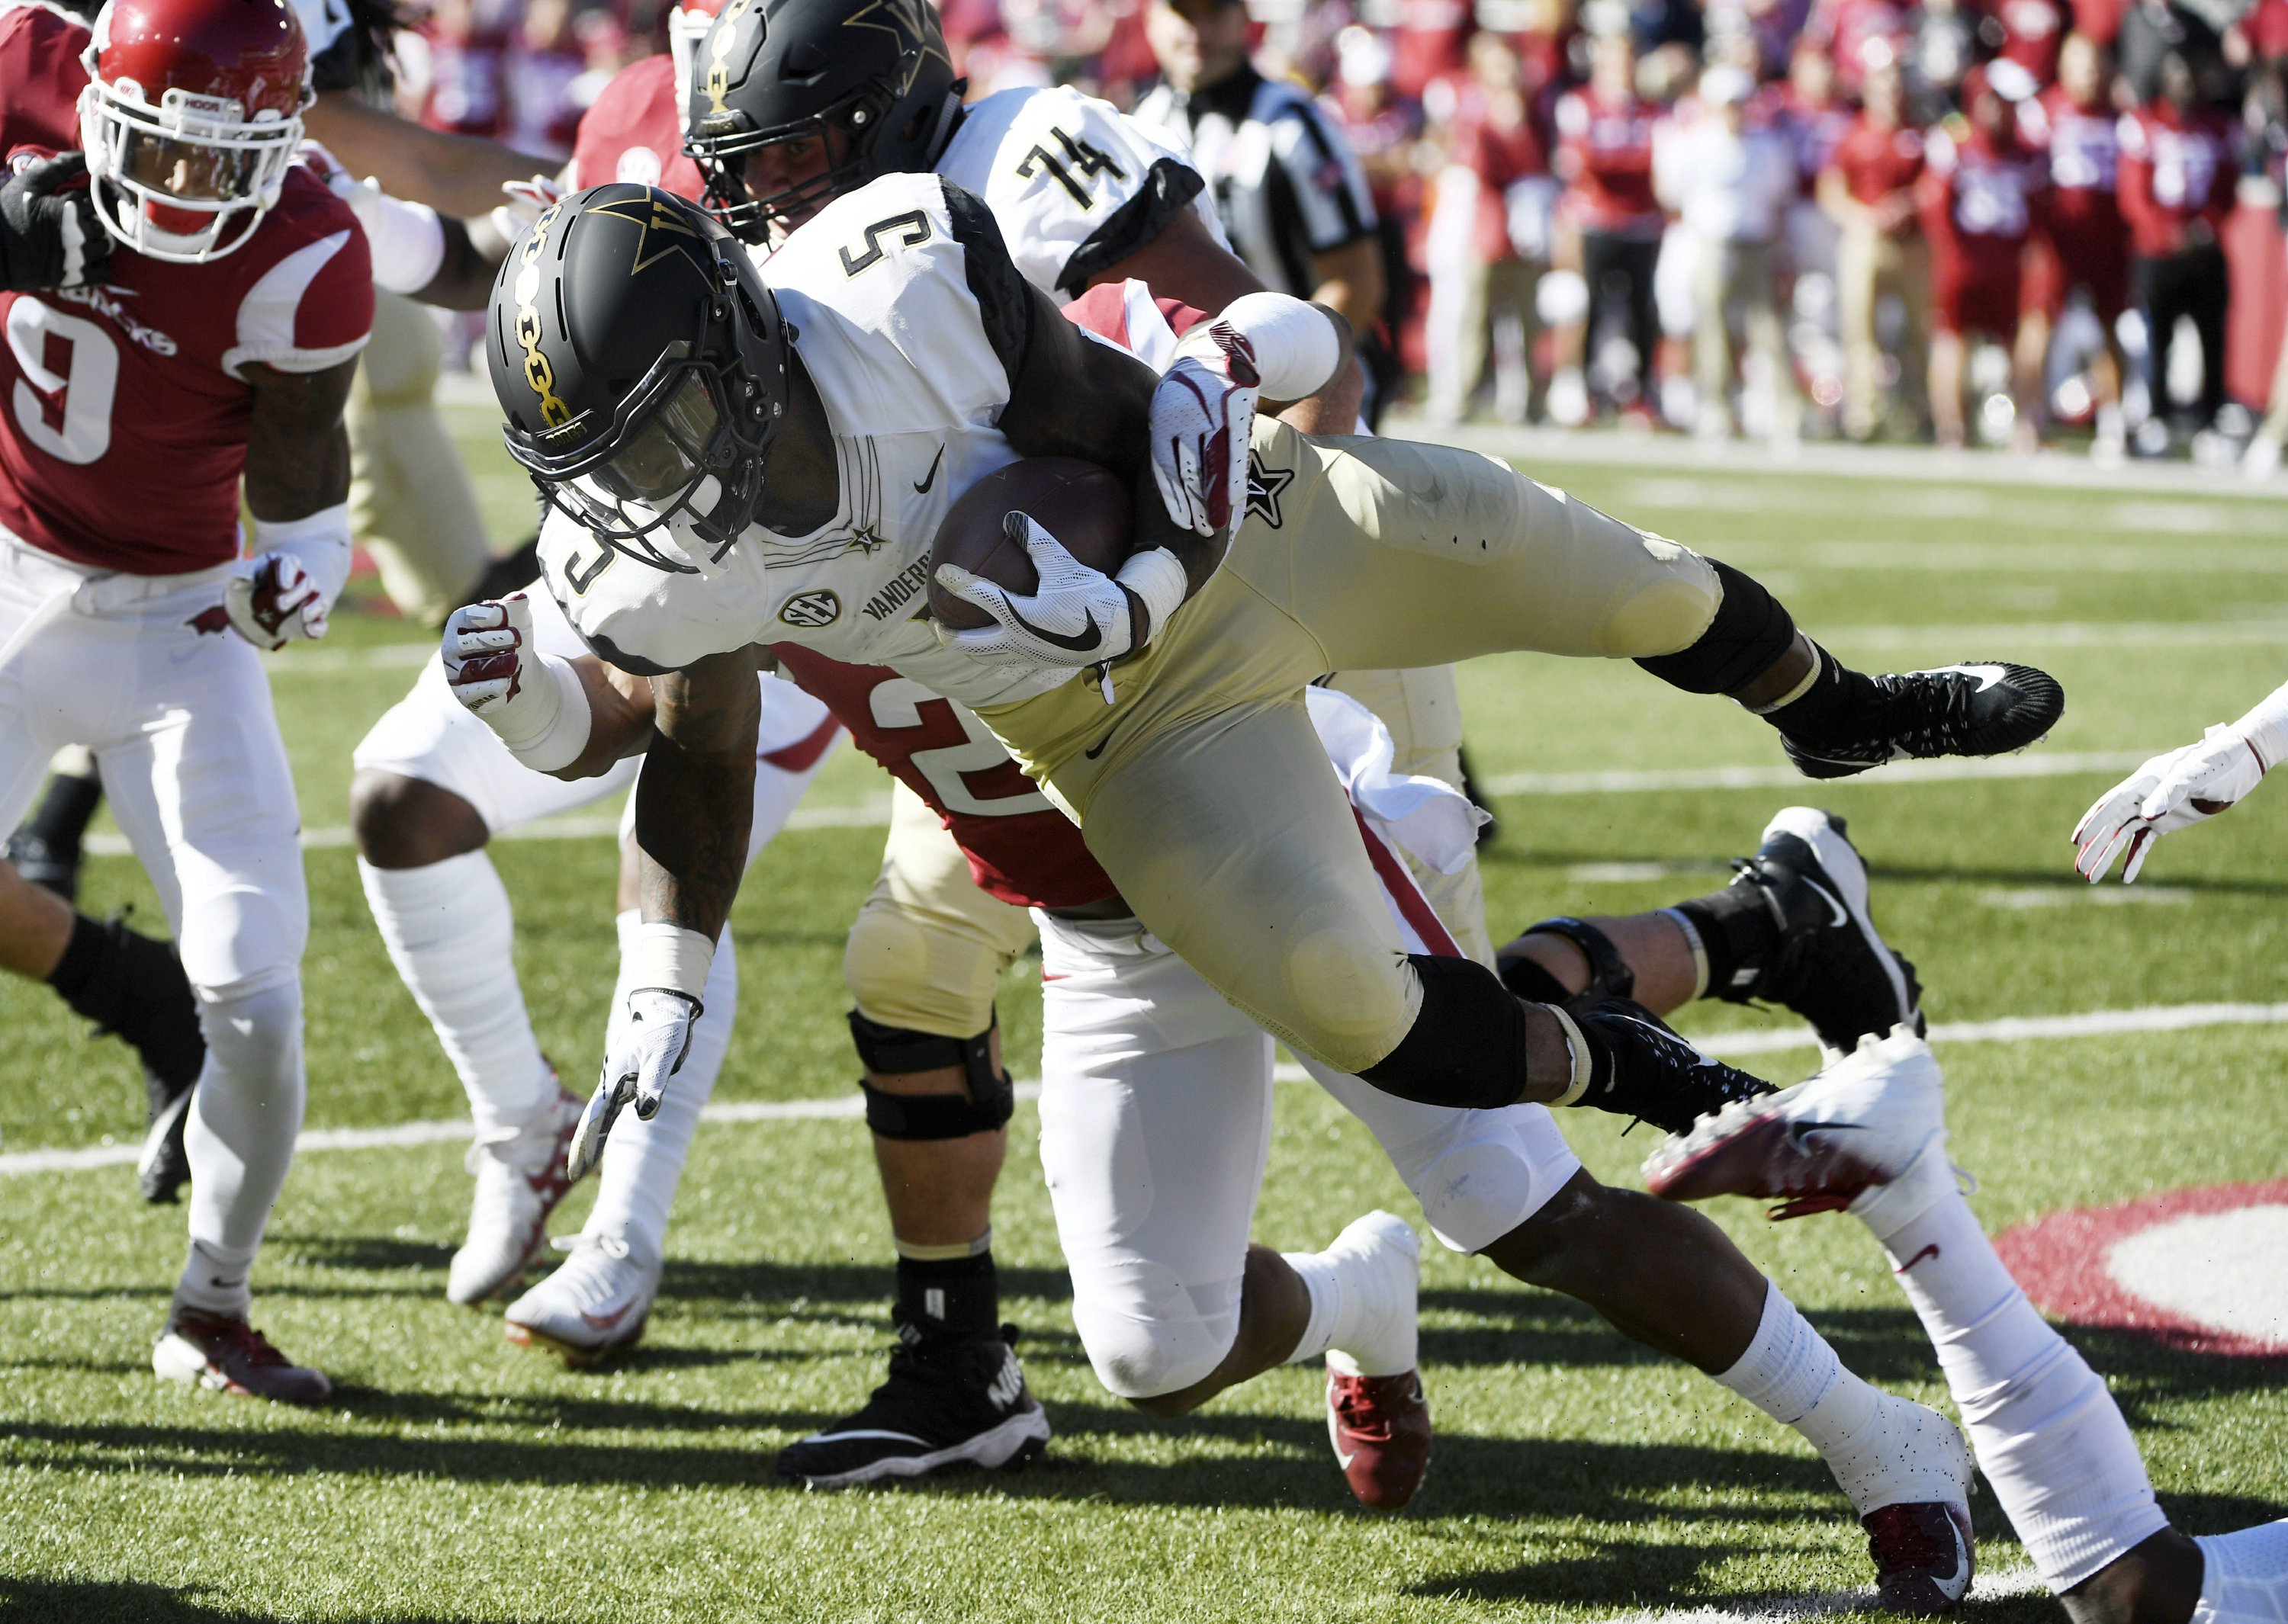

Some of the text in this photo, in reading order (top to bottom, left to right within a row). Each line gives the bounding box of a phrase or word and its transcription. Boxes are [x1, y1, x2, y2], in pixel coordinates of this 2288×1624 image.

[1014, 125, 1128, 213] 74
[837, 206, 934, 281] 5
[6, 295, 120, 465] 9
[782, 592, 838, 626] SEC
[862, 549, 931, 621] VANDER
[869, 677, 1058, 817] 2
